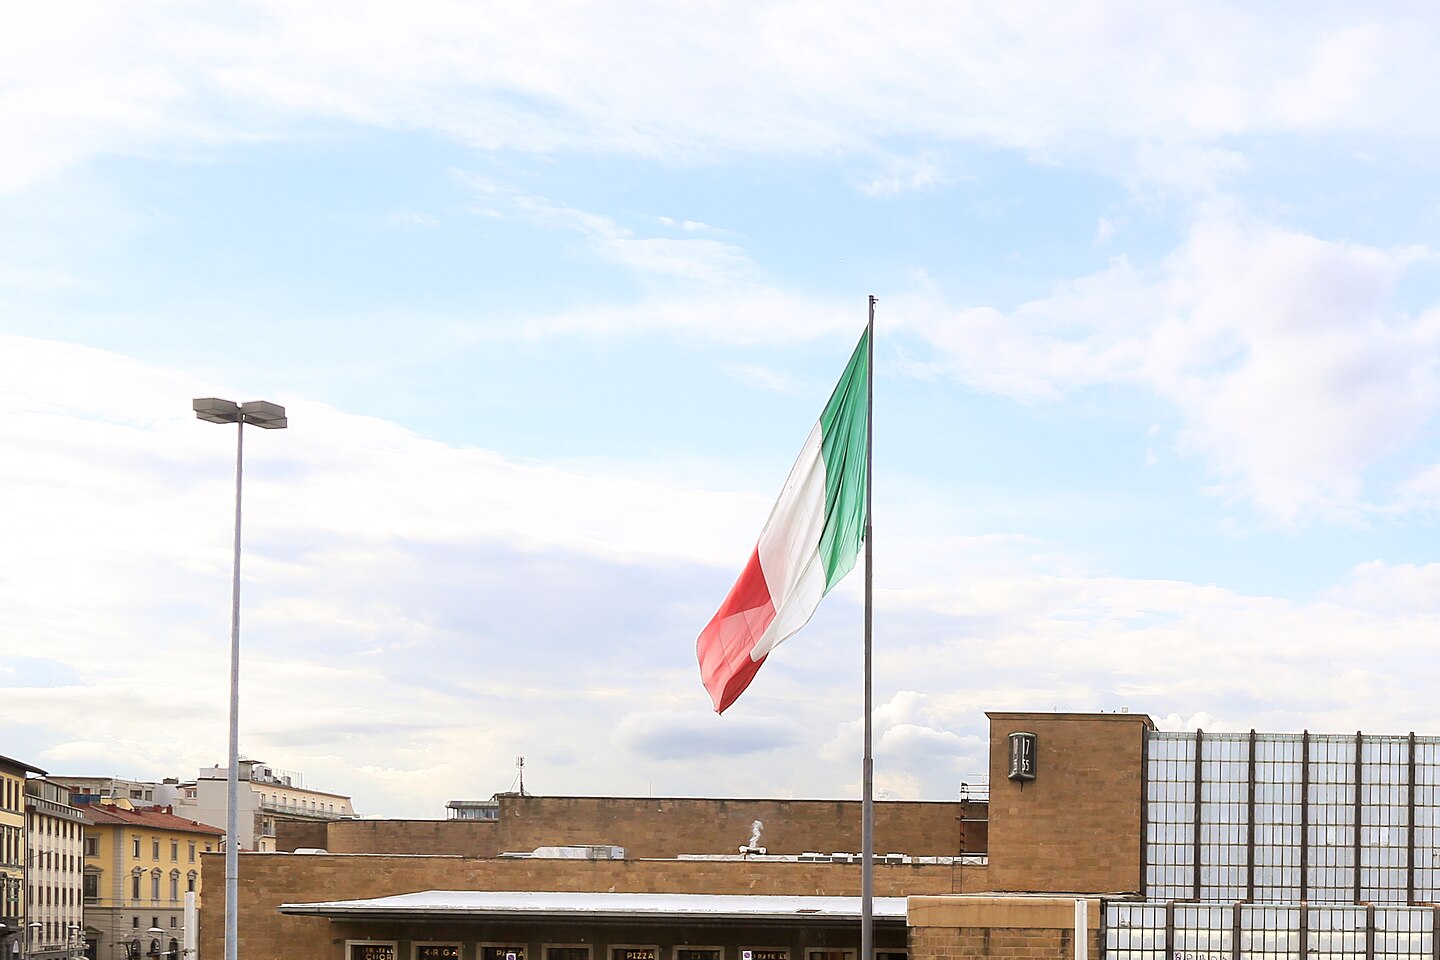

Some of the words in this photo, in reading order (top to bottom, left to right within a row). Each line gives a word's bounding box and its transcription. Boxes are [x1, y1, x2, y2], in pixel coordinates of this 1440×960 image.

[1022, 737, 1030, 755] 17
[1022, 759, 1030, 771] 55
[626, 951, 655, 960] PIZZA
